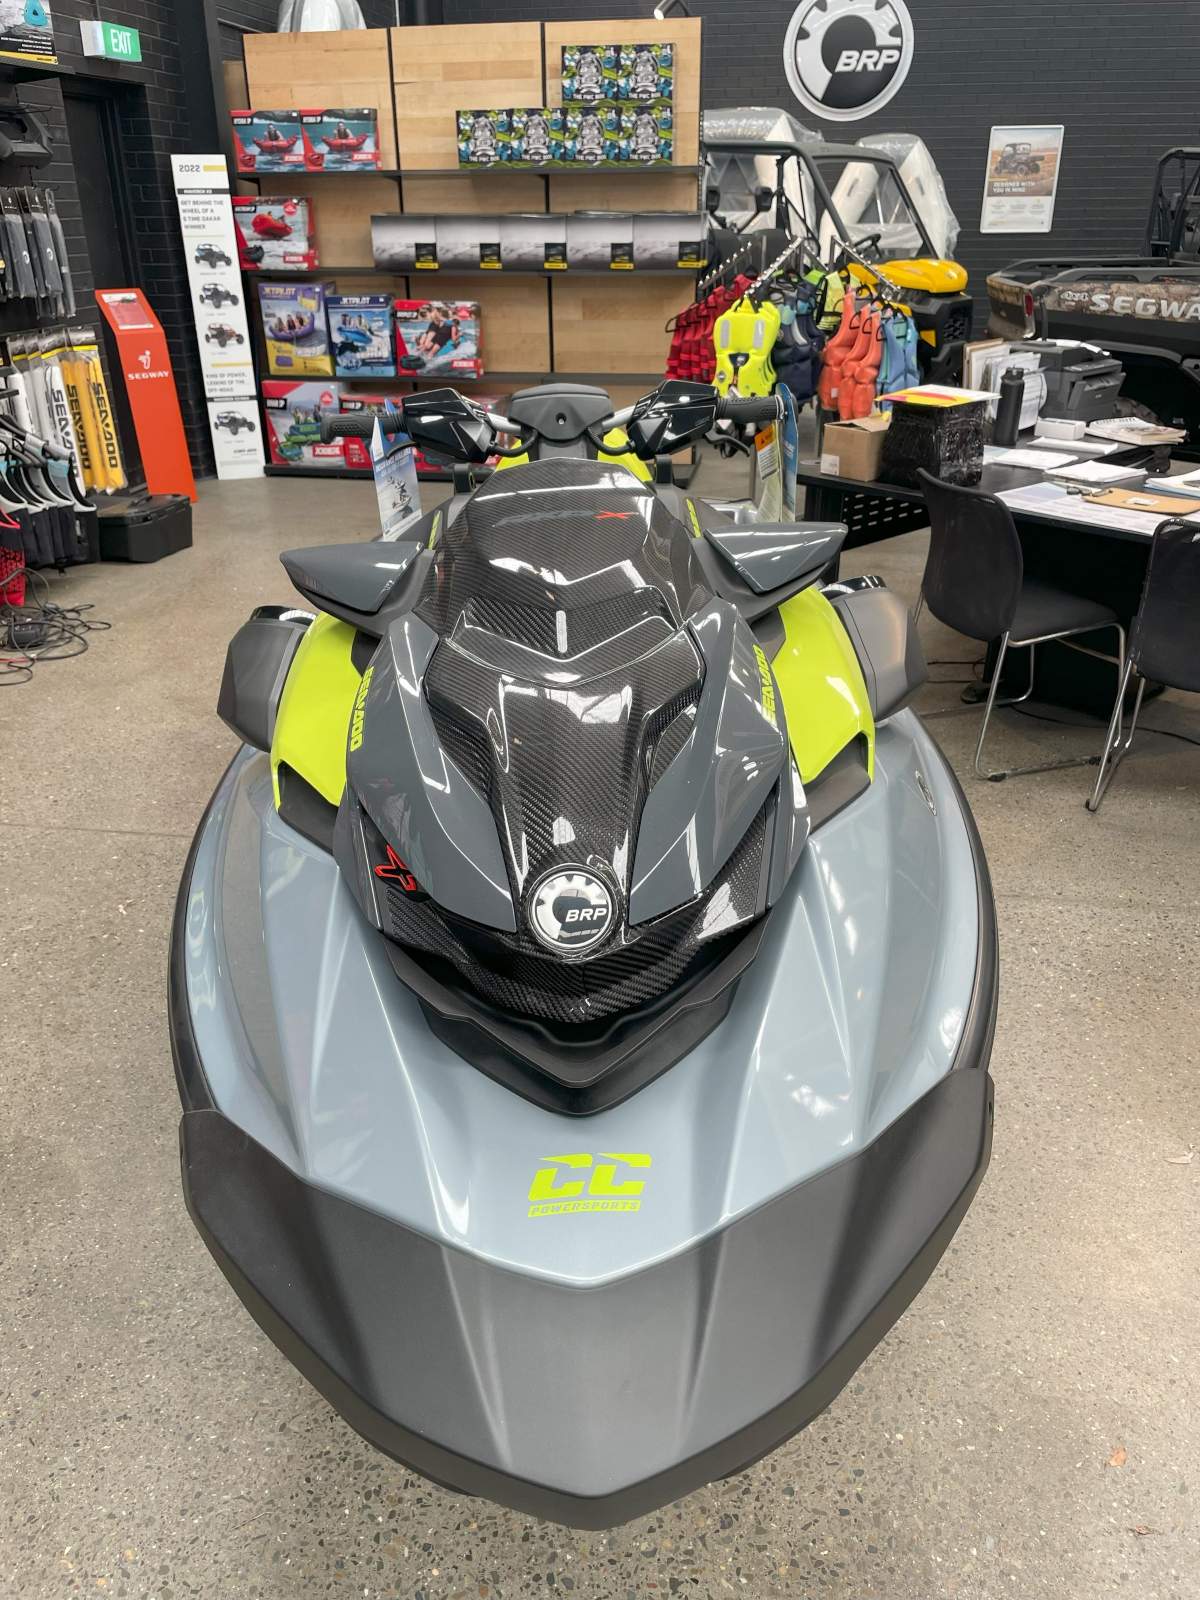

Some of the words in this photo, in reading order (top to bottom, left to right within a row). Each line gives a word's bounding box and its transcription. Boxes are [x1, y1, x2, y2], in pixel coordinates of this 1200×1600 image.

[110, 28, 132, 55] EXIT
[835, 49, 900, 73] BRP
[179, 164, 200, 173] 2022
[127, 371, 169, 381] SEGWAY
[565, 907, 607, 923] BRP
[530, 1201, 639, 1217] POWERSPORTS
